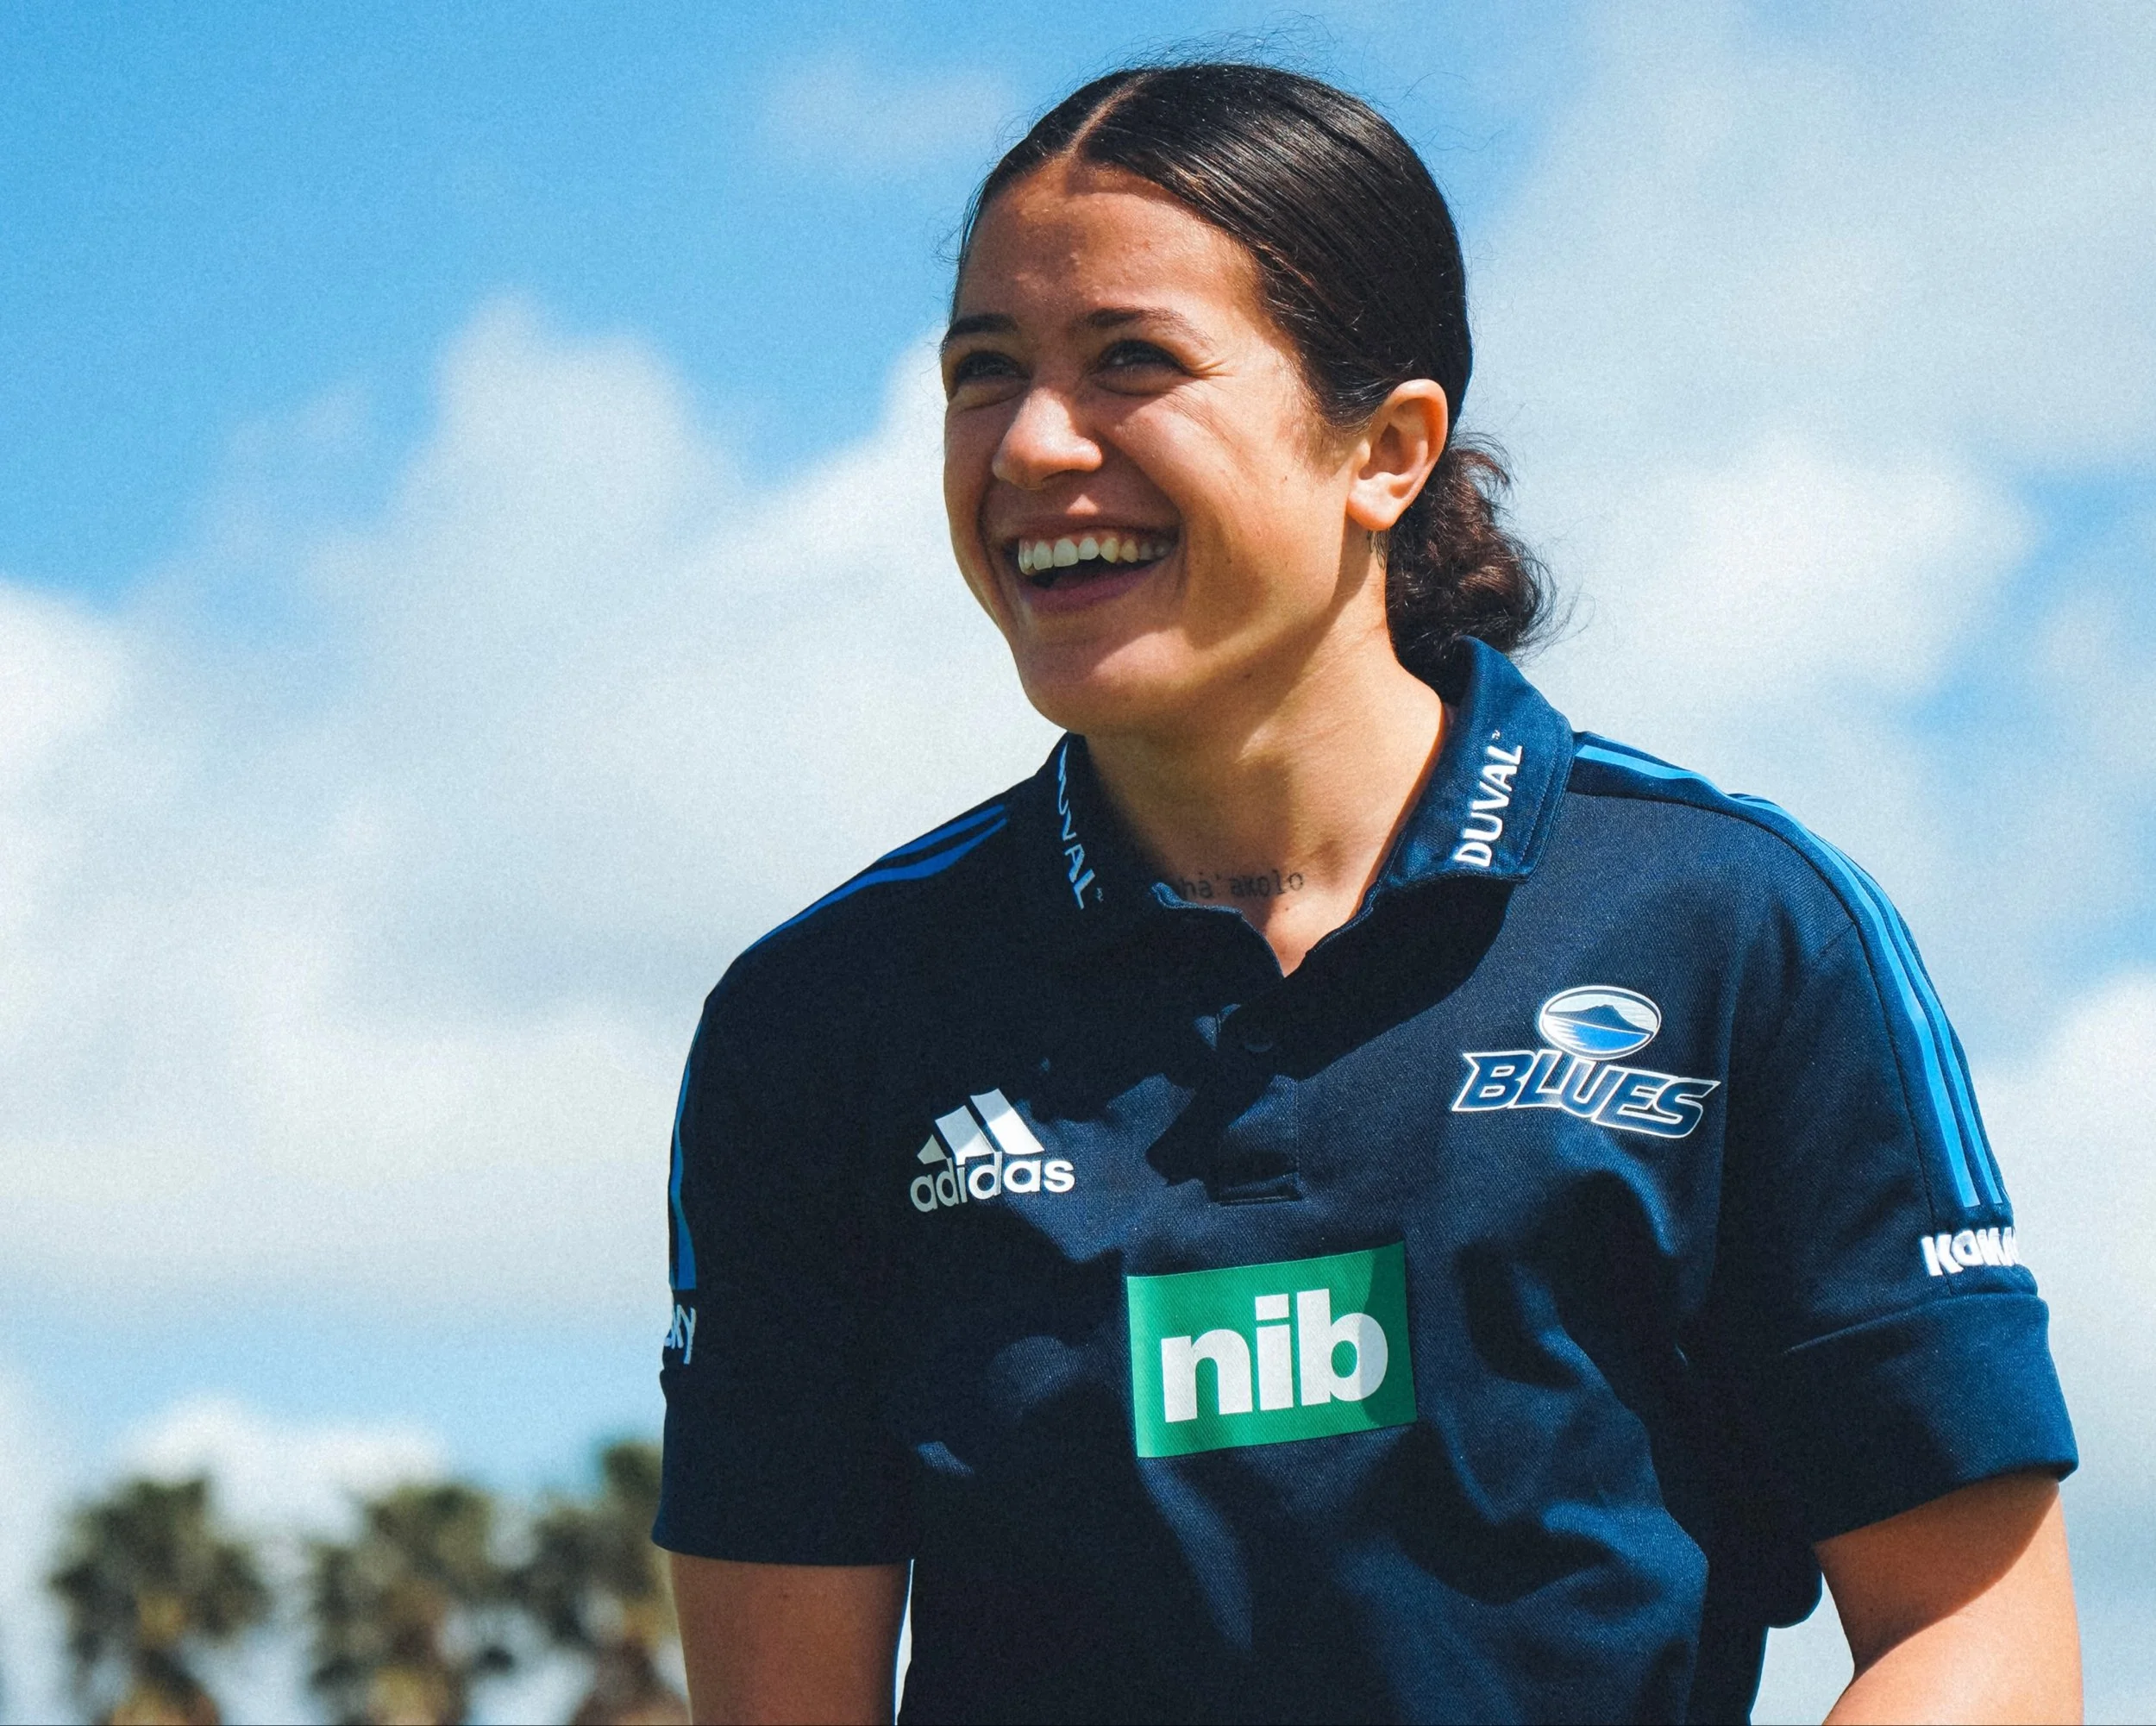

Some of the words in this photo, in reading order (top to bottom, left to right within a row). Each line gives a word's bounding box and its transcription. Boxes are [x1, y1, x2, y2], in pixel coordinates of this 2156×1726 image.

[1454, 744, 1523, 867] DUVAL
[1451, 1049, 1721, 1139] BLUES
[910, 1151, 1075, 1213] adidas
[1921, 1226, 2021, 1277] Kaw
[1161, 1288, 1388, 1423] nib
